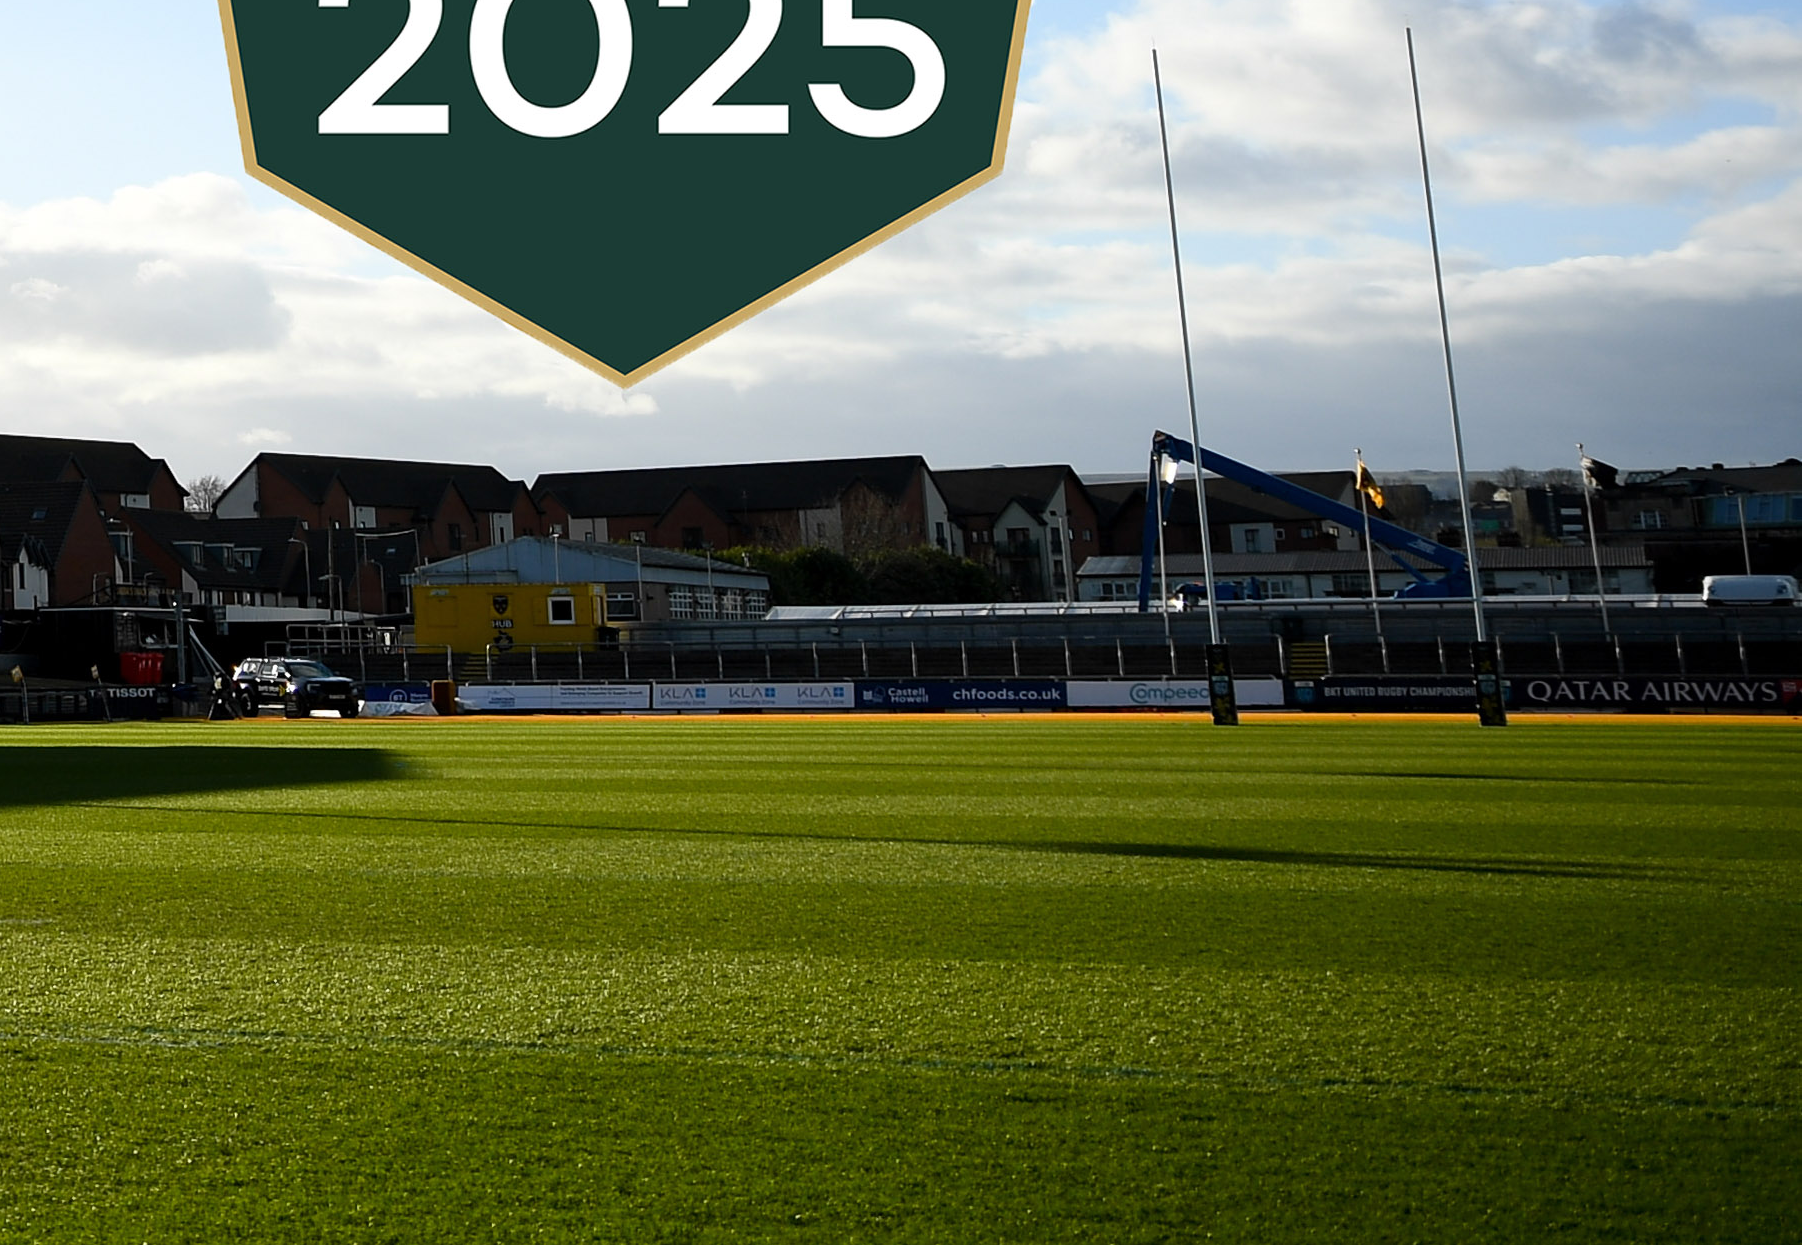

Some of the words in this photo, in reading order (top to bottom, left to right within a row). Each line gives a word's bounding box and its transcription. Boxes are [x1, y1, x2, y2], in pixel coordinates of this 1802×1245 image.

[492, 619, 513, 628] HUB
[108, 687, 156, 698] TISSOT
[661, 688, 693, 699] KLA
[729, 687, 763, 698] KLA
[798, 687, 831, 698] KLA
[888, 687, 925, 697] Castell
[953, 688, 1061, 701] chfoods.co.uk
[1324, 687, 1340, 697] BKT
[1343, 687, 1376, 697] UNITED
[1378, 687, 1408, 697] RUGBY
[1410, 687, 1477, 697] CHAMPIONSHI
[1527, 680, 1633, 702] QATAR
[1641, 681, 1778, 703] AIRWAYS
[891, 695, 929, 704] Howell
